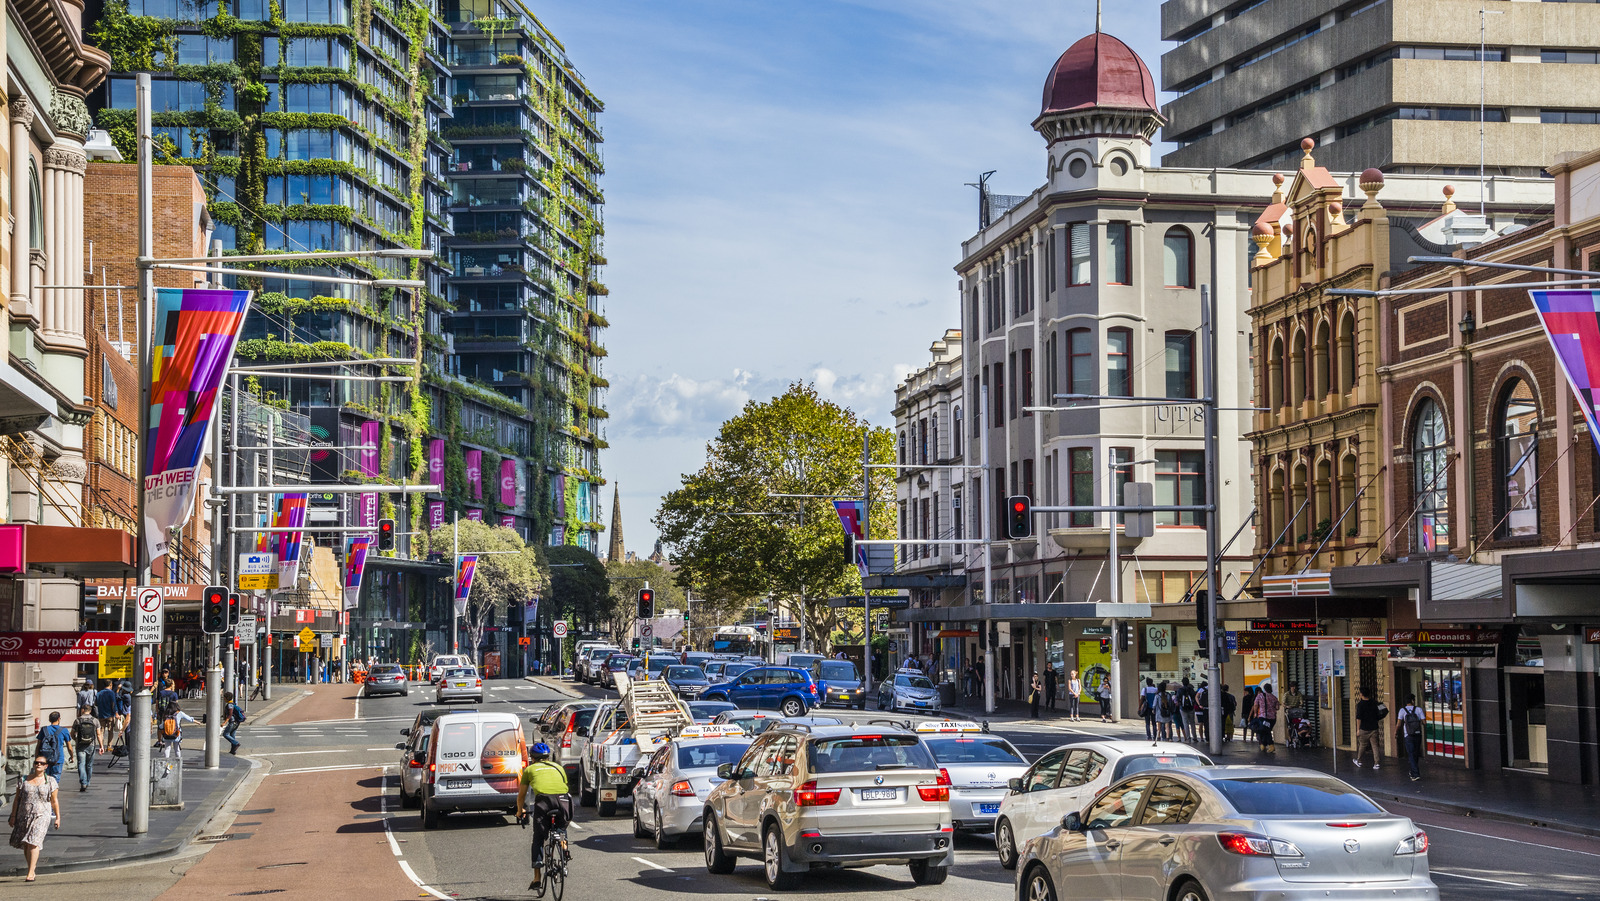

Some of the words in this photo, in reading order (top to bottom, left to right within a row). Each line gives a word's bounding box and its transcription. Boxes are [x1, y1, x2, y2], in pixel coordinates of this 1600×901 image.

[144, 474, 164, 491] OUTH
[147, 487, 164, 503] THE
[97, 585, 128, 597] BAR
[142, 614, 157, 624] NO
[556, 625, 565, 633] 50
[1418, 631, 1471, 642] McDonald's
[37, 638, 81, 647] SYDNEY
[83, 638, 109, 647] CITY
[437, 763, 458, 773] IMPACT
